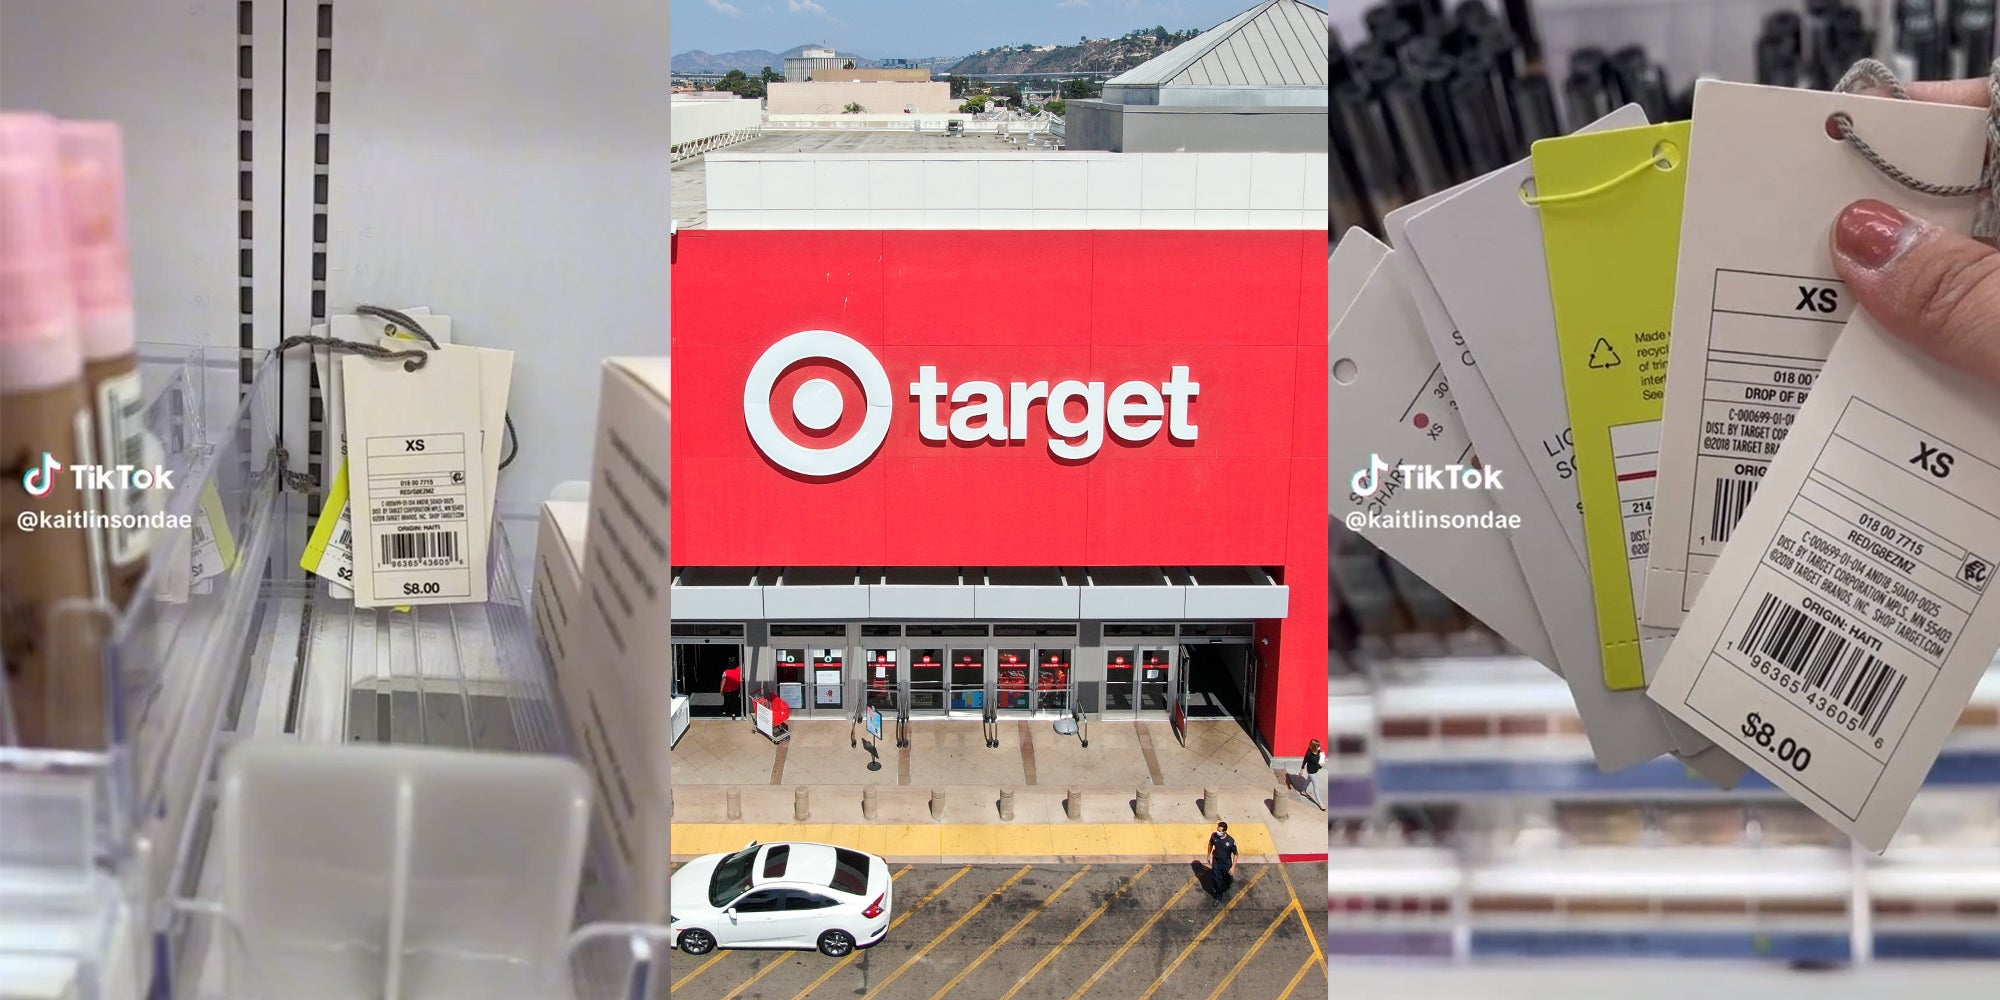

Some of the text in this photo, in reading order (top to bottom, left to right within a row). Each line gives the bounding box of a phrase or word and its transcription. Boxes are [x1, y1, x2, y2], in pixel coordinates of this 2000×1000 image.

[1796, 286, 1838, 313] XS
[1635, 330, 1666, 343] Made
[1774, 370, 1812, 385] 018 00
[1642, 390, 1664, 400] See
[1745, 387, 1776, 401] DROP
[1780, 390, 1795, 403] OF
[910, 366, 1200, 460] target
[1427, 423, 1444, 440] XS
[1706, 421, 1726, 435] DIST.
[1728, 423, 1738, 436] BY
[1740, 424, 1770, 440] TARGET
[406, 439, 425, 452] XS
[1704, 436, 1730, 450] ©2018
[1732, 439, 1762, 454] TARGET
[1909, 441, 1954, 478] XS
[1632, 501, 1652, 514] 214
[1700, 536, 1705, 546] 1
[1858, 514, 1924, 556] 018 00 7715
[1802, 530, 1867, 575] C-000699-01-014
[1848, 530, 1916, 574] RED/G8EZMZ
[392, 559, 418, 568] 96365
[423, 558, 450, 566] 43605
[403, 582, 440, 595] $8.00
[1776, 534, 1796, 554] DIST.
[1795, 545, 1808, 560] BY
[1806, 550, 1836, 576] TARGET
[1833, 568, 1888, 606] CORPORATION
[1910, 612, 1927, 629] MN
[1924, 620, 1952, 644] 55403
[1769, 548, 1795, 570] ©2018
[1793, 562, 1822, 586] TARGET
[1872, 608, 1896, 629] SHOP
[1895, 622, 1944, 659] TARGET.COM
[1802, 596, 1883, 652] ORIGIN: HAITI
[1727, 641, 1884, 750] 1 96365 43605 6
[1741, 712, 1812, 772] $8.00
